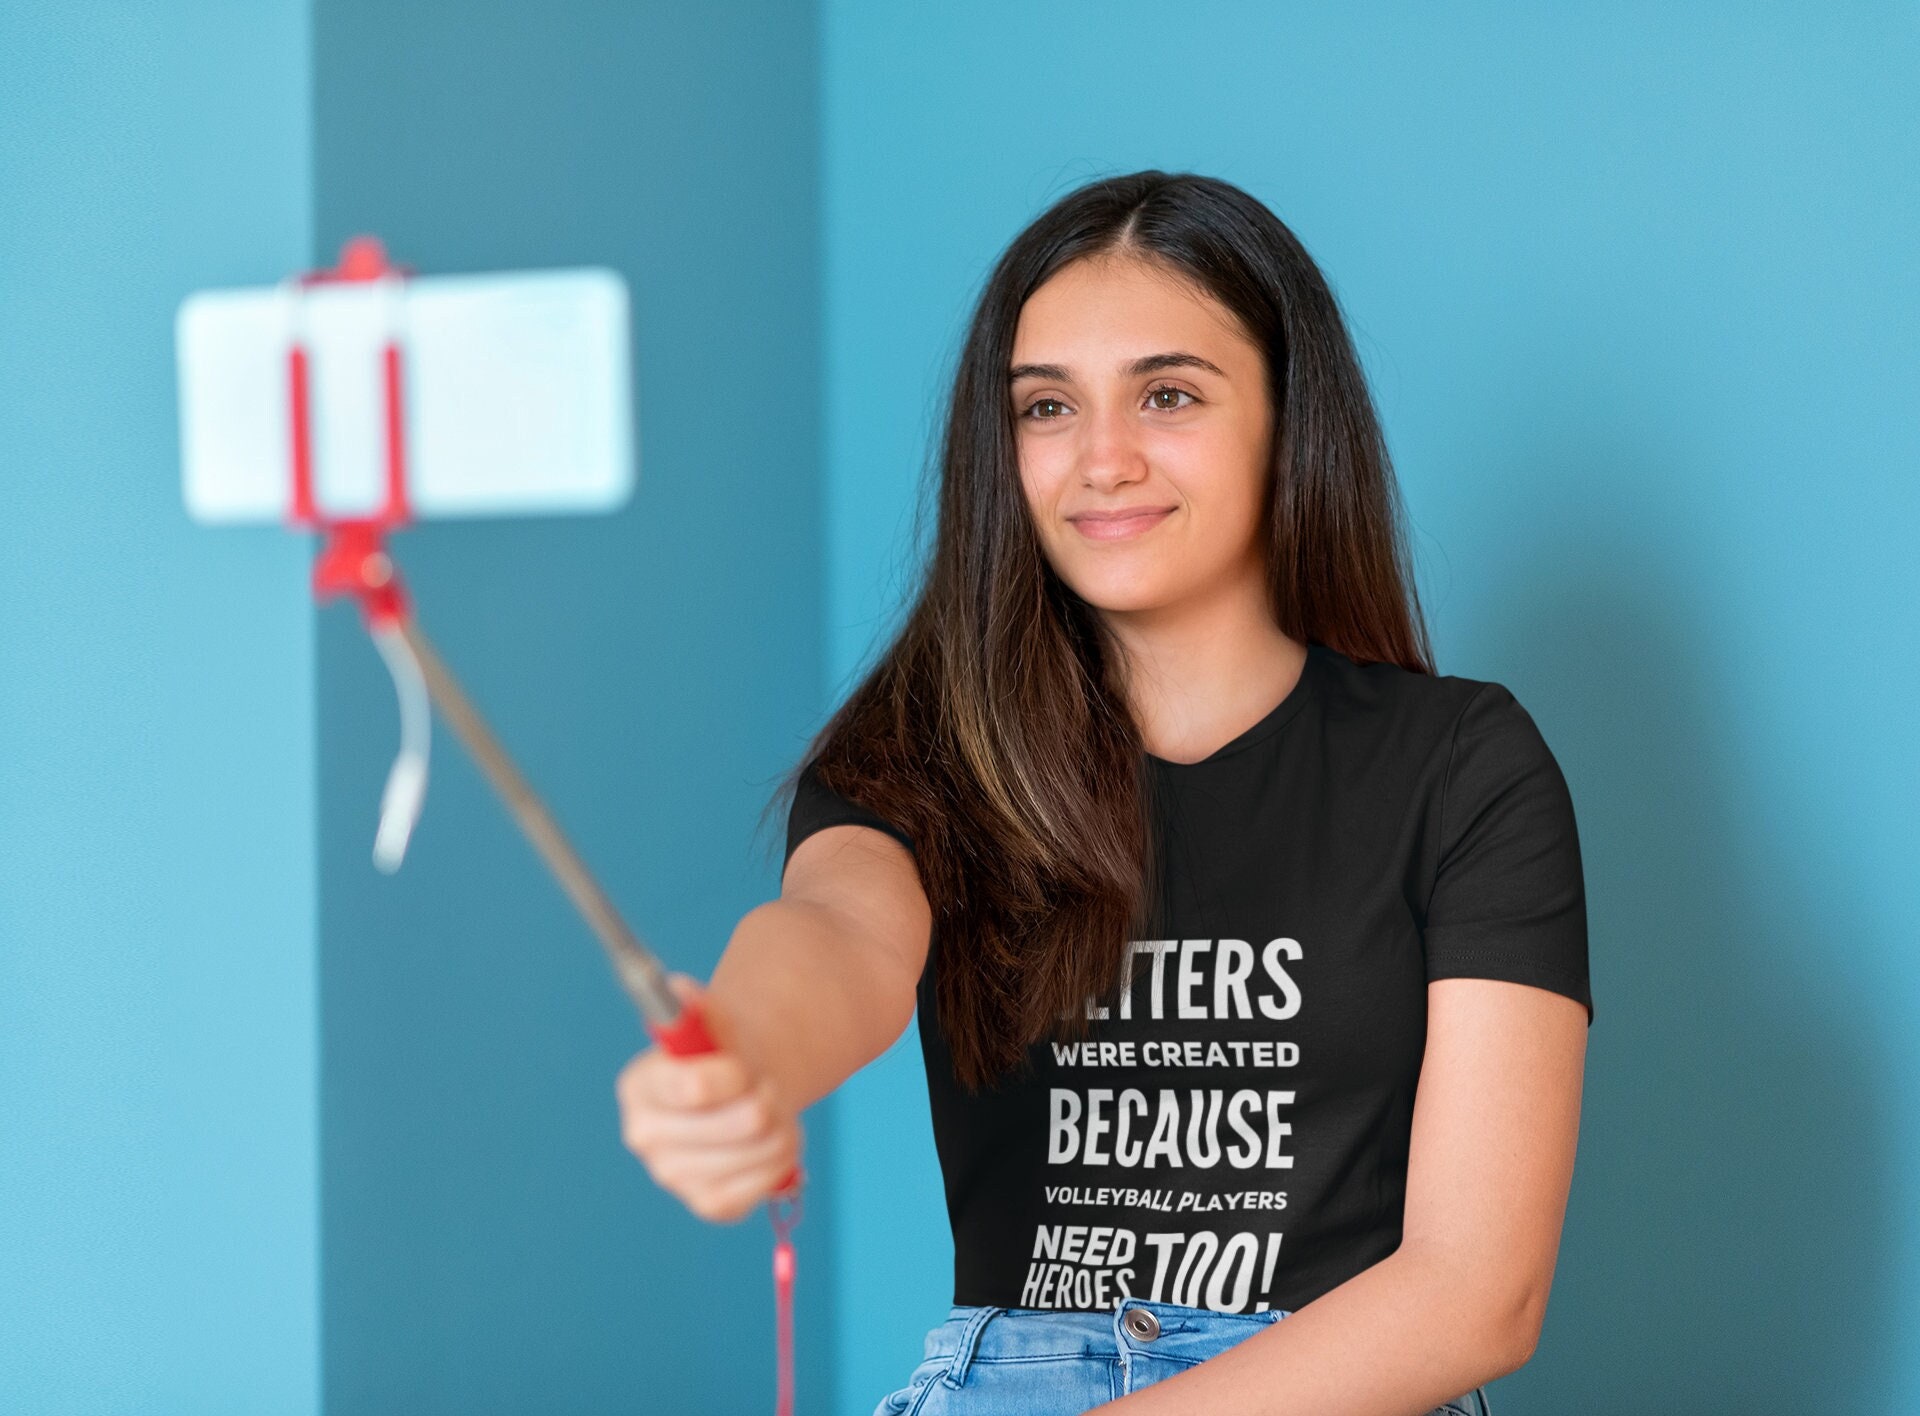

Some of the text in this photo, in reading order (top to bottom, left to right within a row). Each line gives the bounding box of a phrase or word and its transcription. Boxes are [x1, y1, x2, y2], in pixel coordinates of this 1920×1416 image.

[1054, 938, 1303, 1020] TTERS
[1051, 1042, 1300, 1067] WERE CREATED
[1048, 1088, 1296, 1169] BECAUSE
[1045, 1186, 1288, 1212] VOLLEYBALL PLAYERS
[1032, 1225, 1137, 1264] NEED
[1020, 1262, 1136, 1310] HEROES
[1145, 1230, 1283, 1314] TOO!
